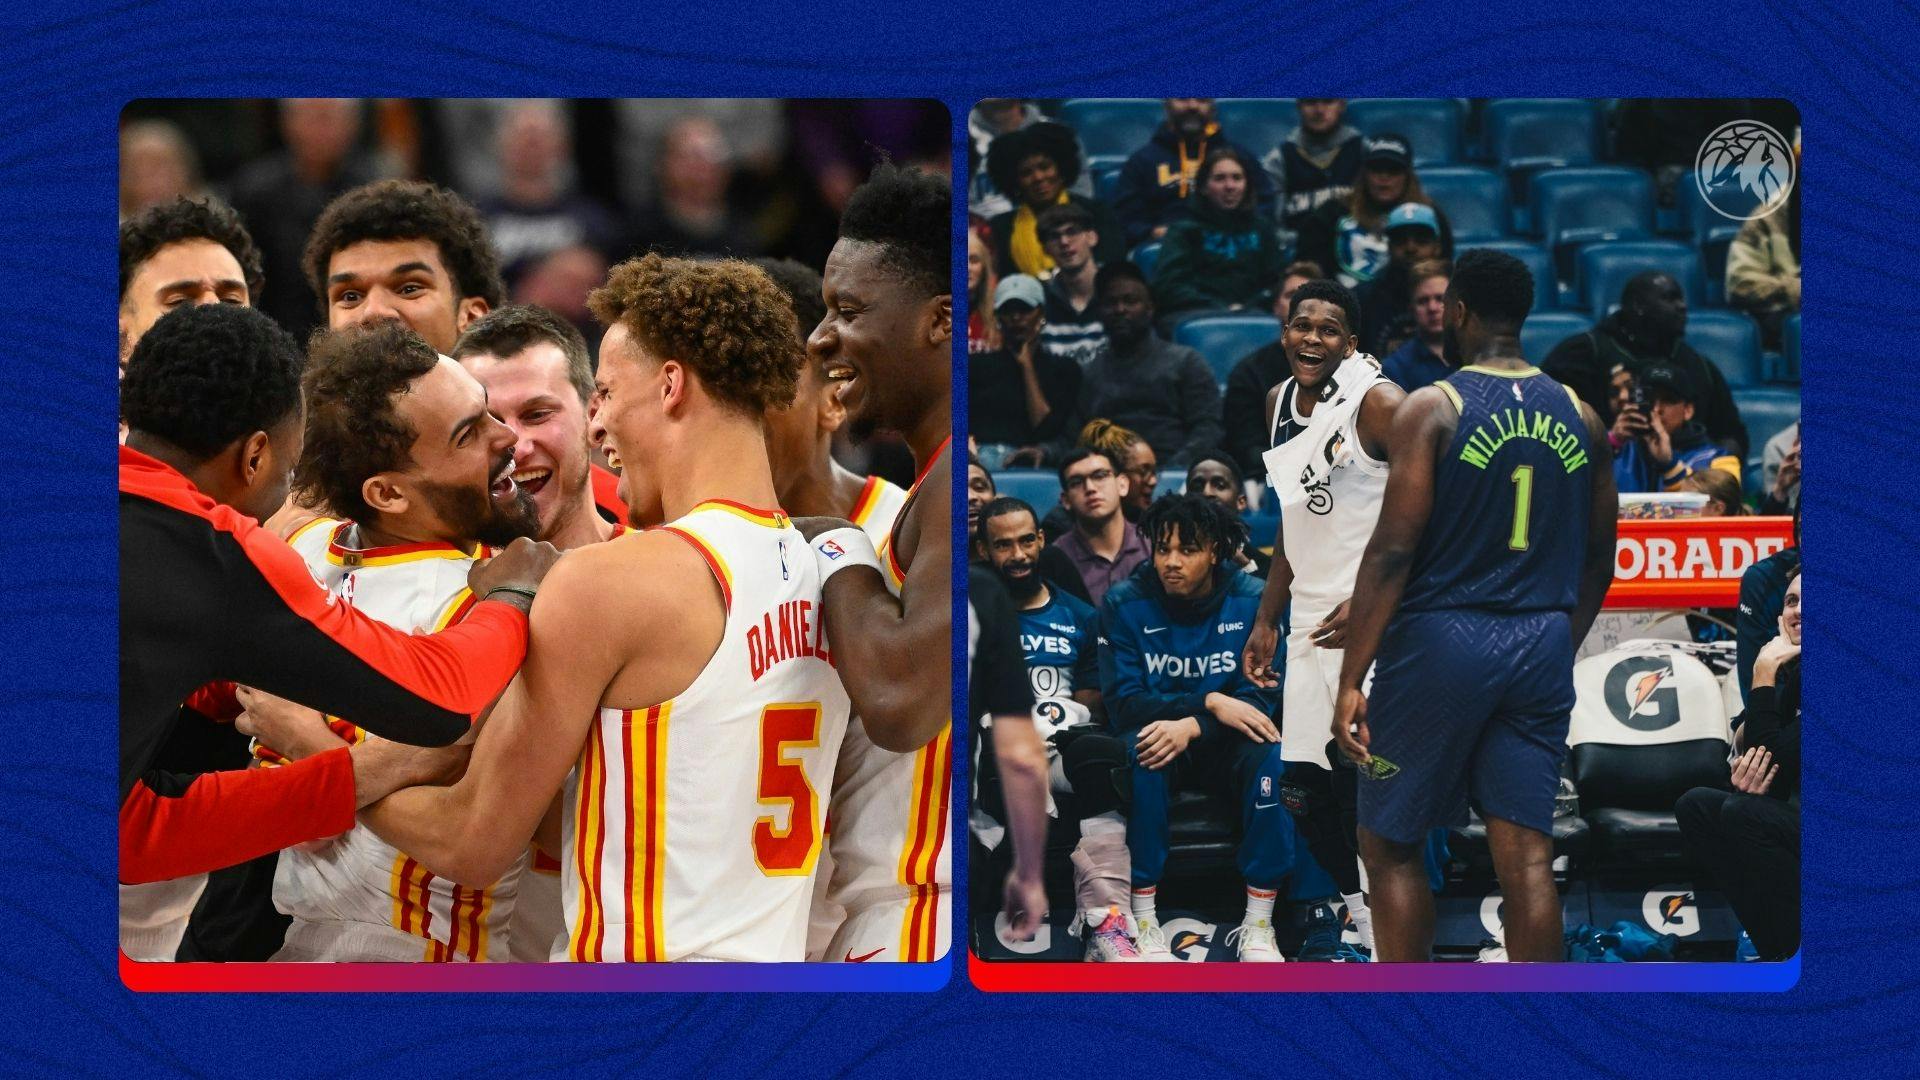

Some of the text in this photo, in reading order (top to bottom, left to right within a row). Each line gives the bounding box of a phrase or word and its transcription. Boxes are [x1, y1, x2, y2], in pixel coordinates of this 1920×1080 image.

[1459, 408, 1589, 475] WILLIAMSON
[1509, 464, 1535, 551] 1
[1614, 537, 1785, 580] ORAD
[746, 599, 838, 682] DANIEL
[1020, 634, 1072, 655] LVES
[1225, 621, 1244, 632] UHC
[1144, 650, 1237, 678] WOLVES
[1604, 655, 1681, 732] G
[751, 701, 823, 877] 5
[1642, 890, 1701, 937] G
